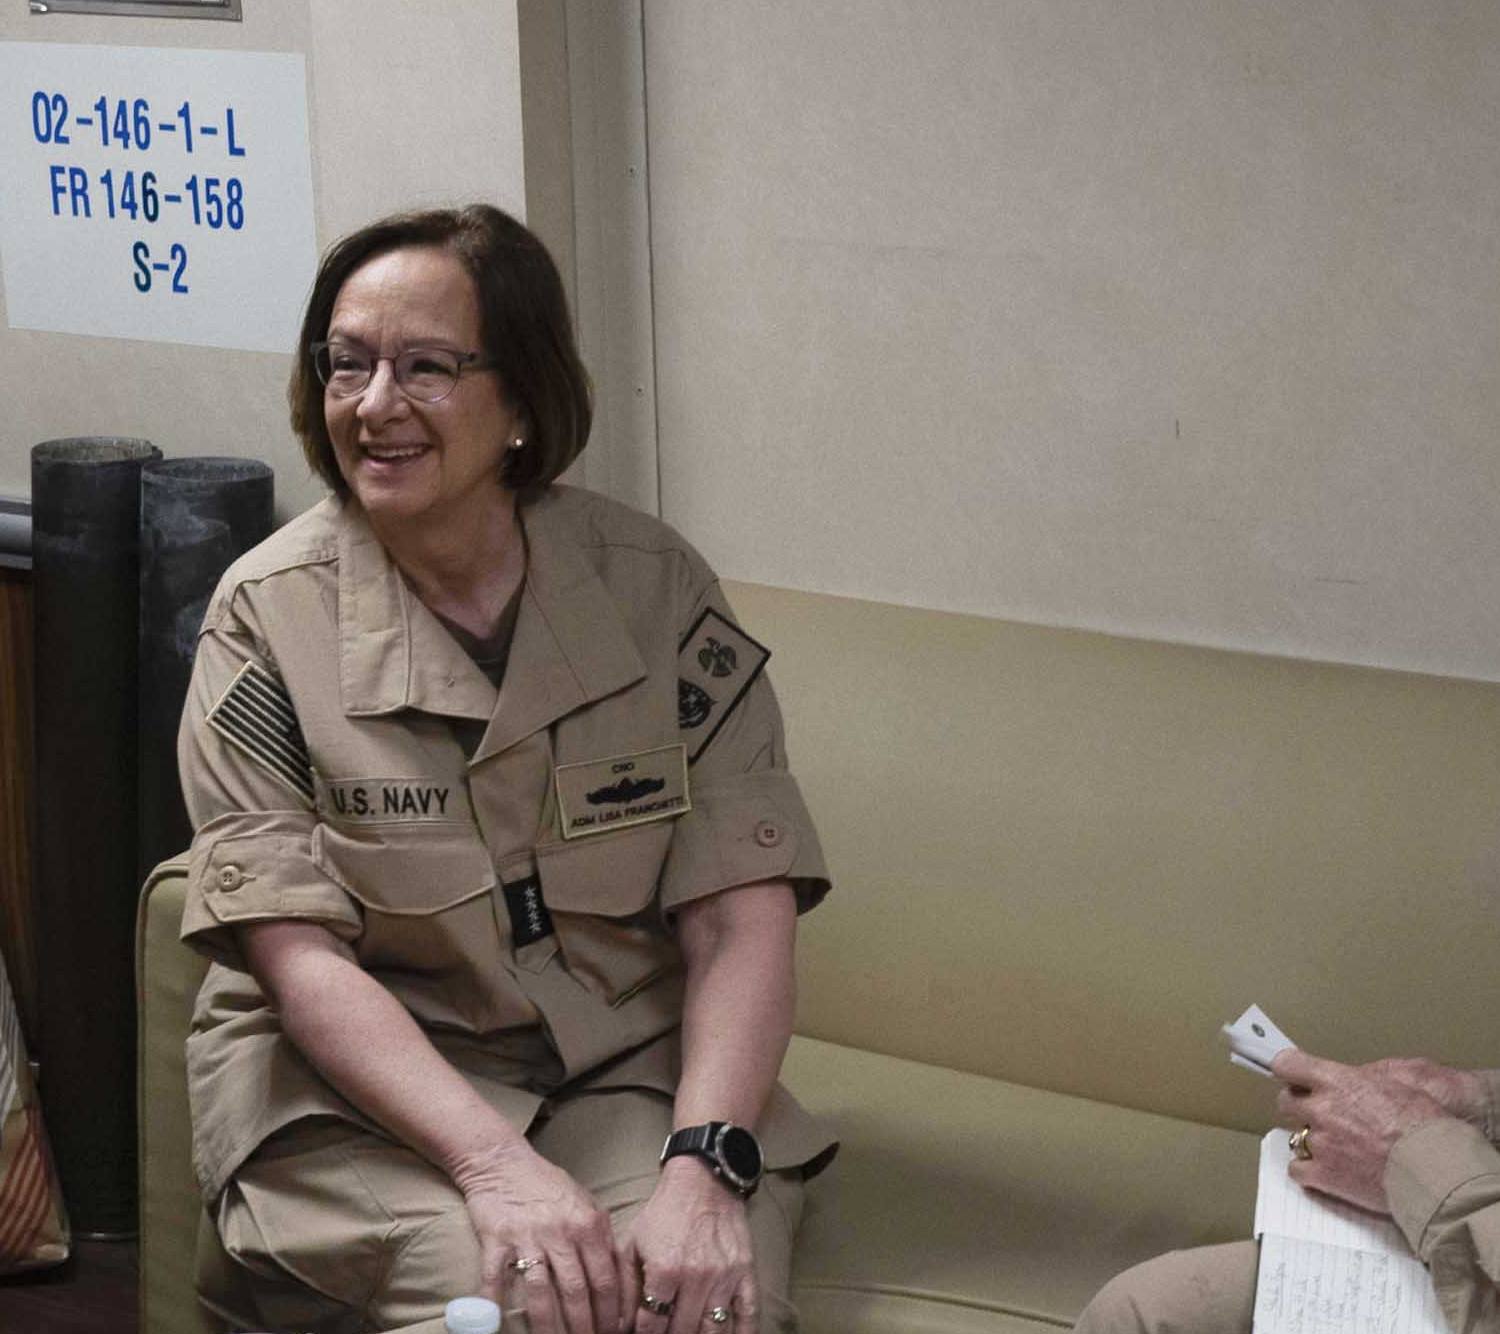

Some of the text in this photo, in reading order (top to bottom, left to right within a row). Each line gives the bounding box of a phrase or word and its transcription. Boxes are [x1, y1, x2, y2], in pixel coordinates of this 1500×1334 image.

[50, 165, 245, 231] FR 146-158
[132, 240, 190, 294] S-2
[329, 786, 450, 816] U.S. NAVY
[571, 815, 596, 828] ADM
[599, 809, 622, 823] LISA
